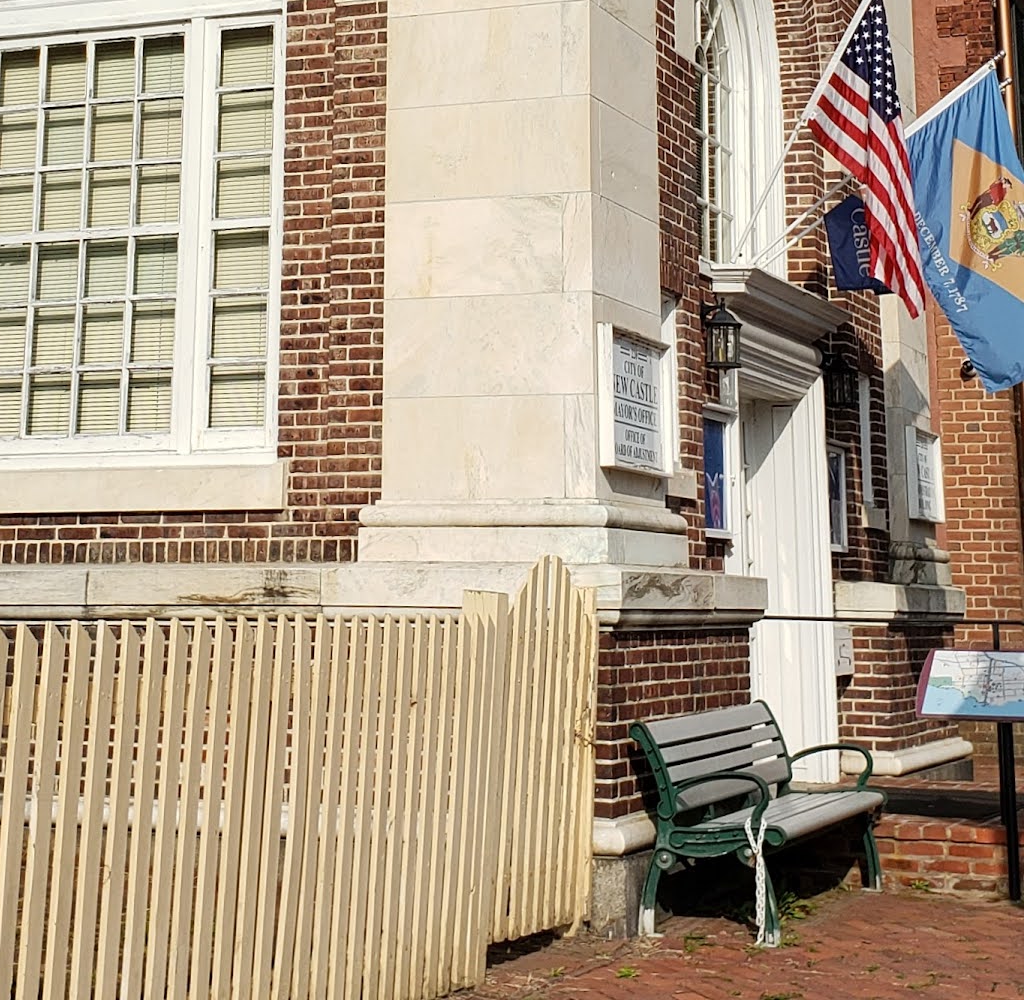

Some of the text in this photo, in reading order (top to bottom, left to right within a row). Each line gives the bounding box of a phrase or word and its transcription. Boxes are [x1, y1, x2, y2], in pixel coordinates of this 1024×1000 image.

[914, 210, 950, 277] DECEMBER
[624, 360, 644, 379] CITY OF
[629, 378, 658, 405] CASTLE
[637, 407, 657, 427] OFFICE
[614, 442, 626, 456] OARD
